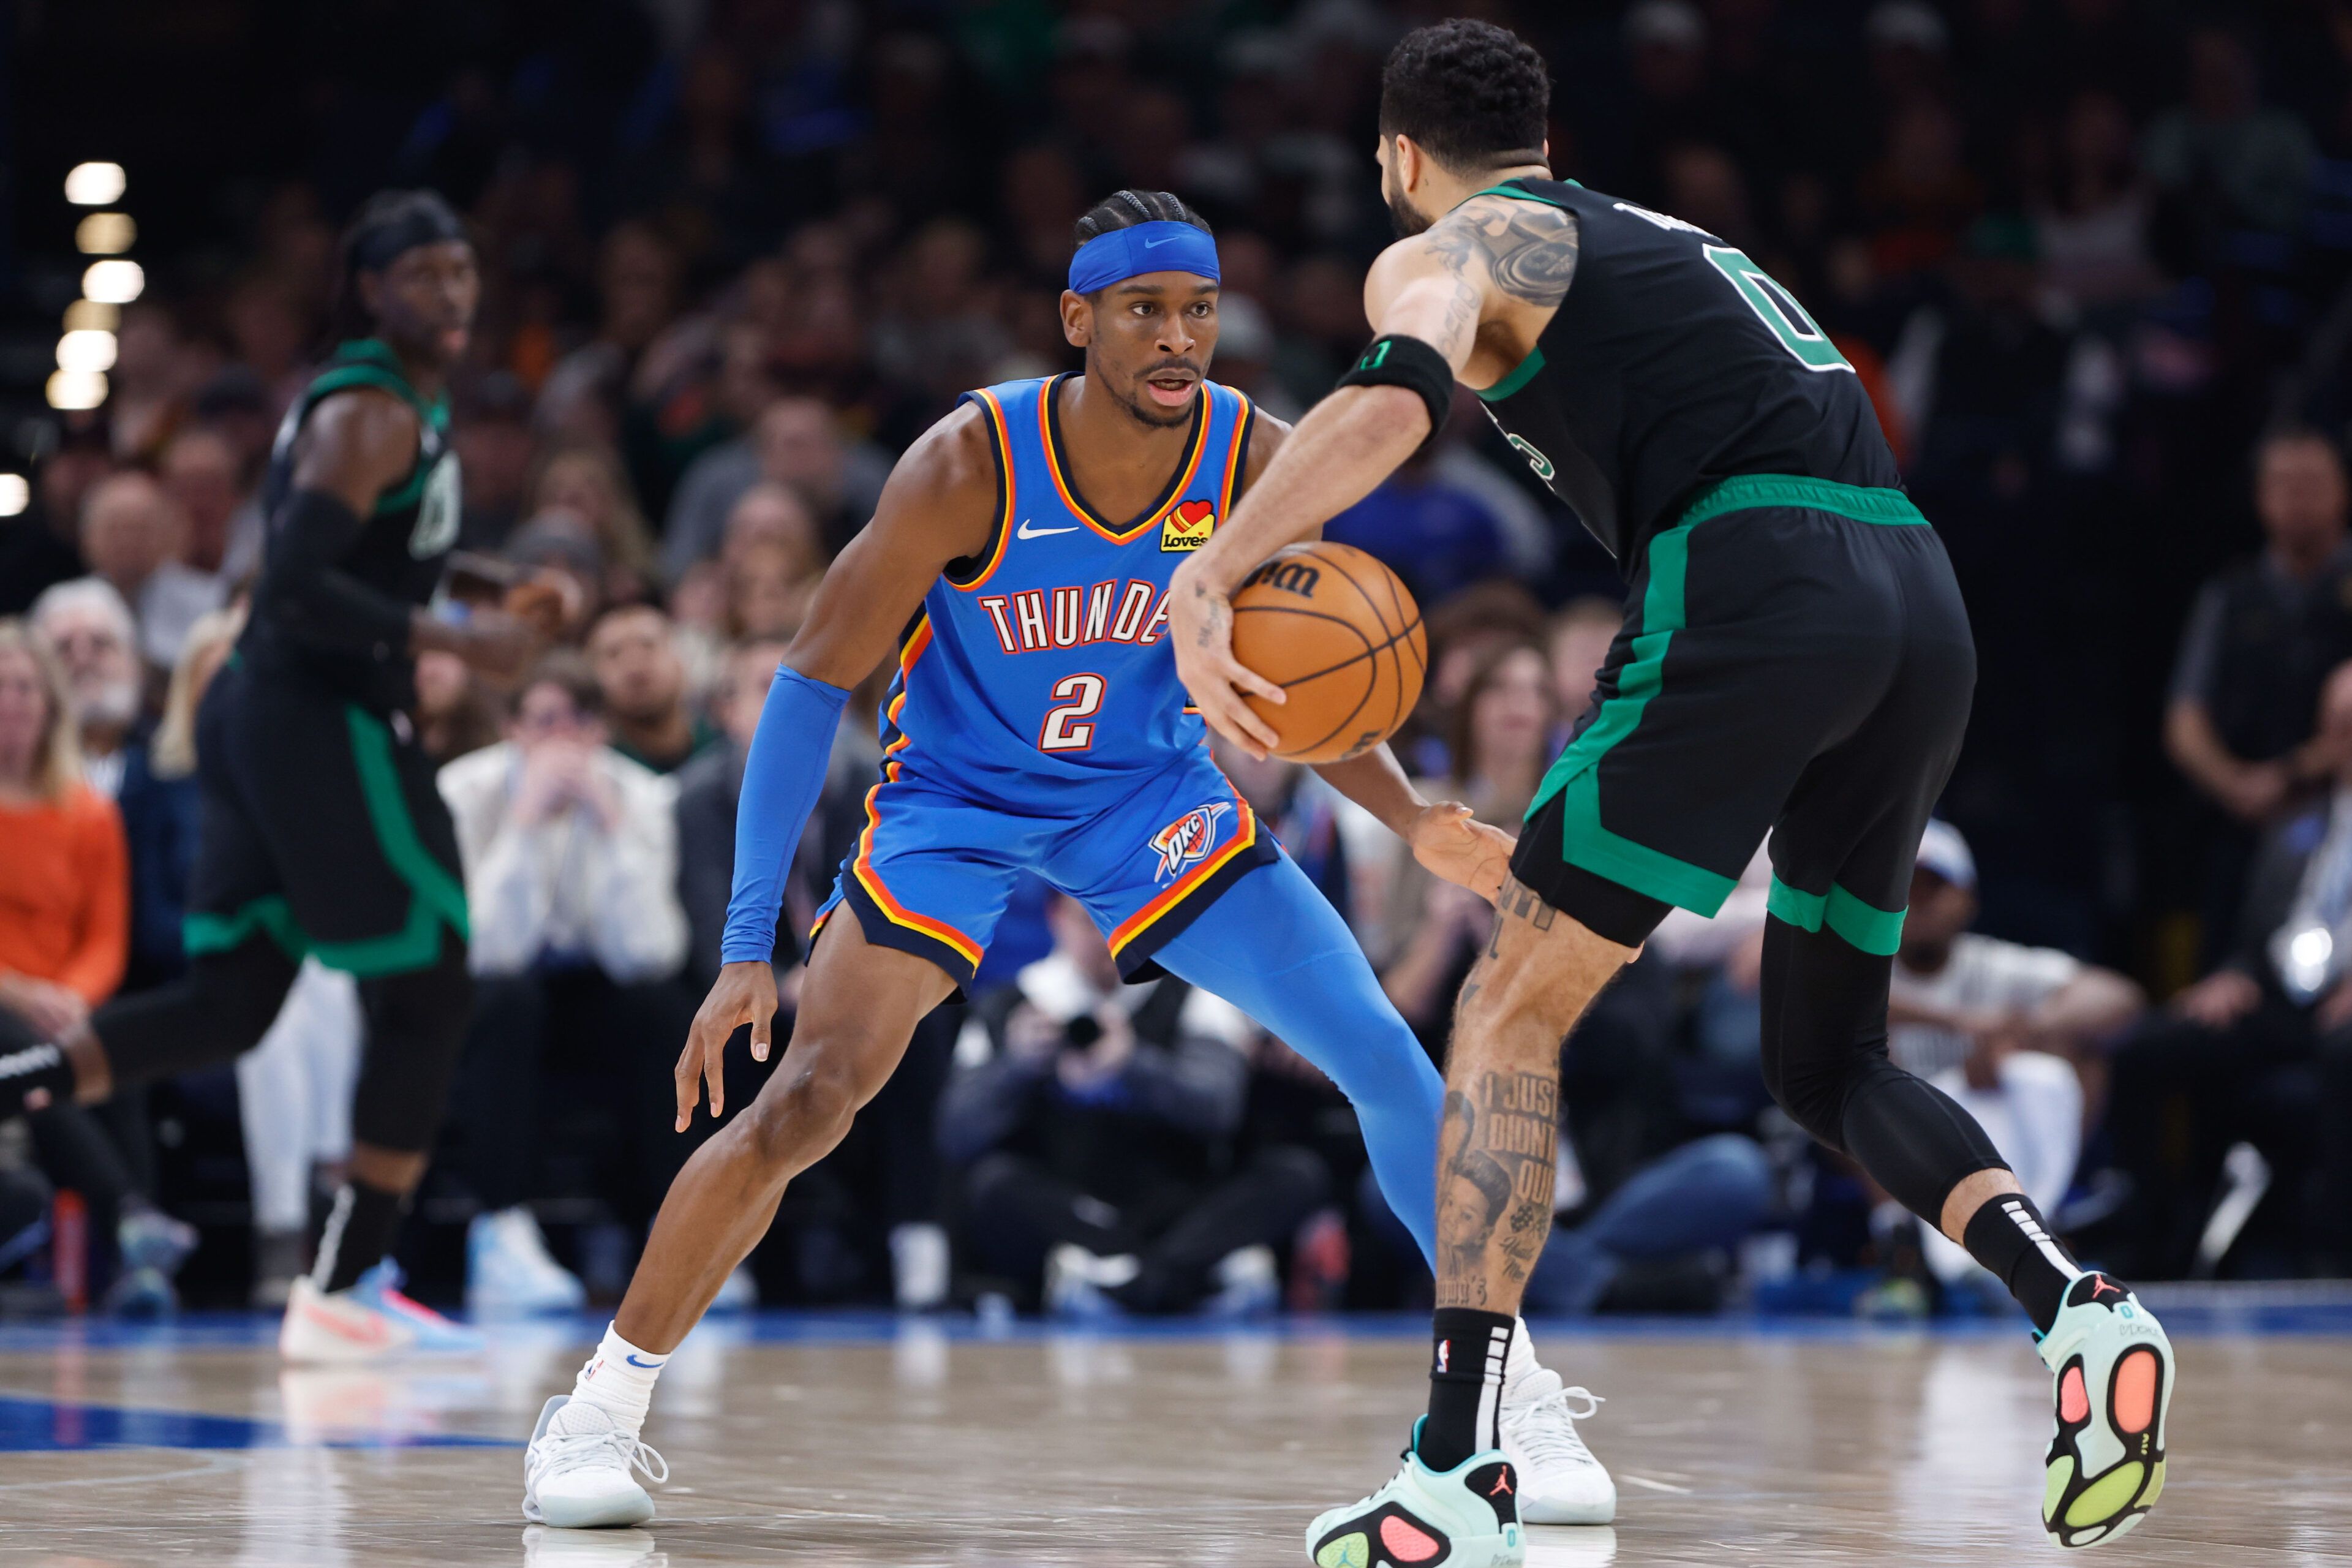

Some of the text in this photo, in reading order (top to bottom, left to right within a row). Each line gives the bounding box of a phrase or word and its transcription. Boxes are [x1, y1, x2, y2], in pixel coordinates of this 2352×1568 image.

[1702, 243, 1856, 374] 0
[977, 578, 1170, 654] THUNDE
[1038, 672, 1107, 753] 2
[1167, 814, 1201, 872] OKC
